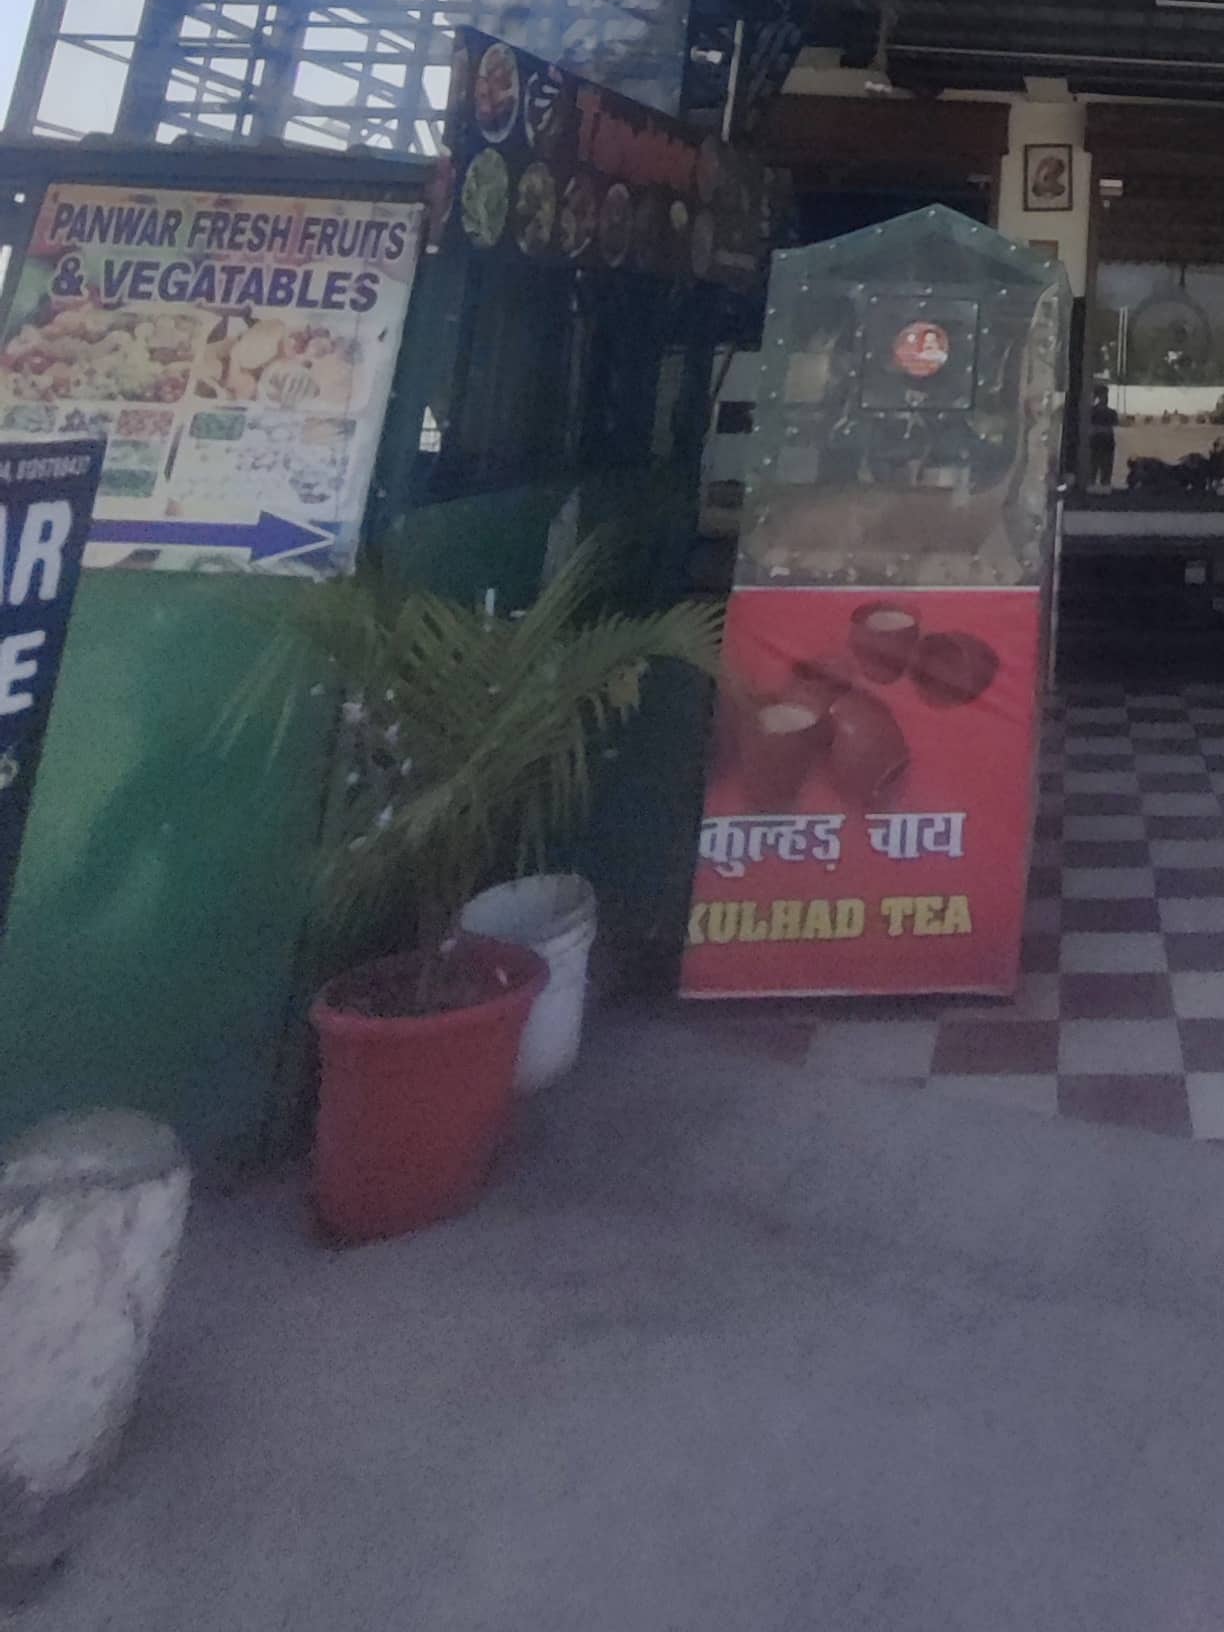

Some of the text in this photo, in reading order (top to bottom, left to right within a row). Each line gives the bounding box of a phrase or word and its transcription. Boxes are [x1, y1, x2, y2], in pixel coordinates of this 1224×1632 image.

[50, 203, 408, 261] PANWAR FRESH FRUITS
[52, 256, 381, 313] & VEGATABLES
[0, 500, 72, 605] R
[698, 812, 966, 878] कुल्हड़ चाय
[881, 895, 972, 937] TEA
